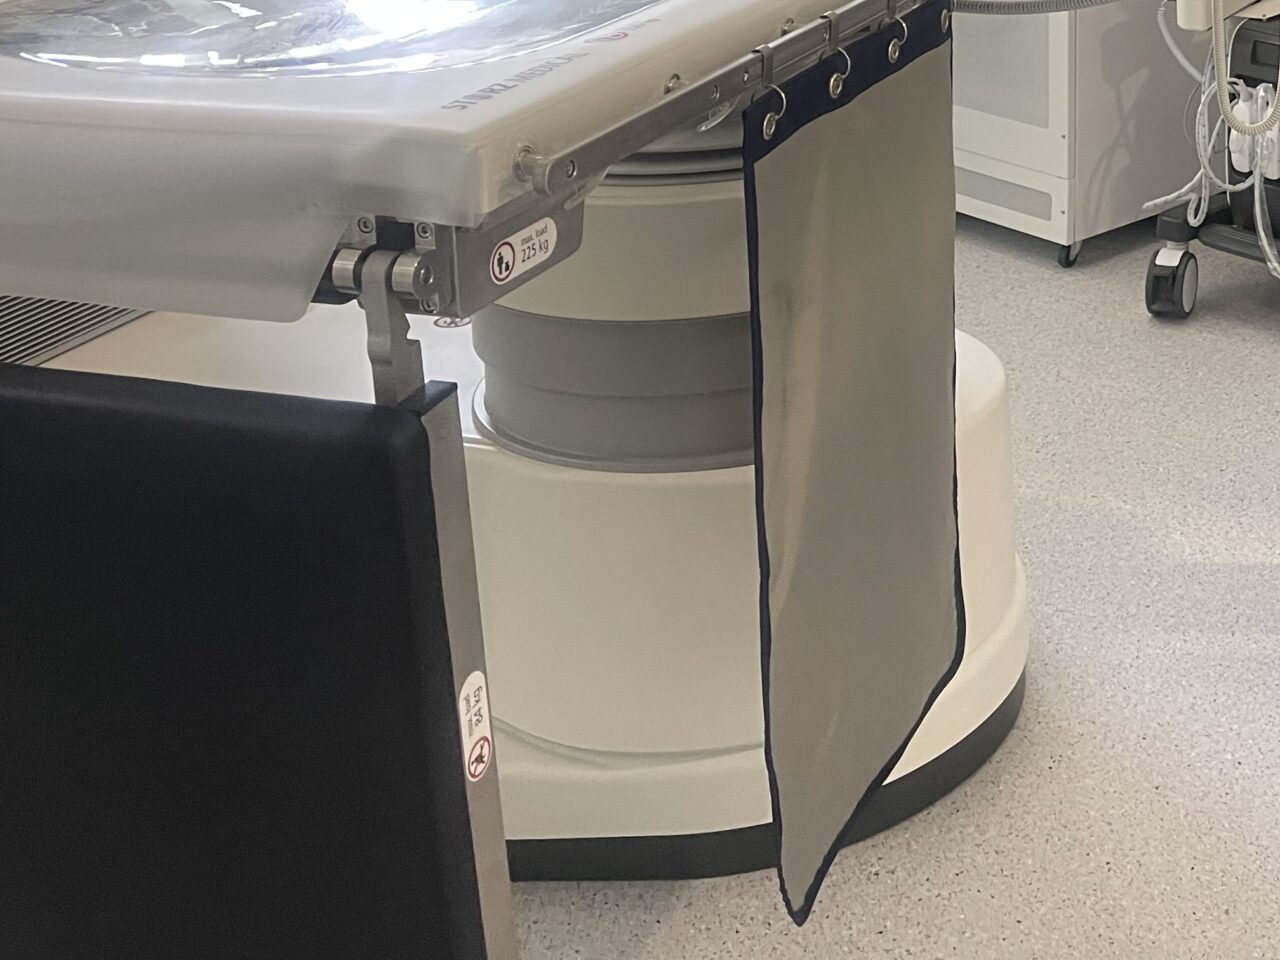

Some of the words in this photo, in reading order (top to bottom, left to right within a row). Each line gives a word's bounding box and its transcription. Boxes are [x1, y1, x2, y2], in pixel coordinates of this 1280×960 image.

[535, 222, 548, 238] load
[521, 242, 537, 263] 225
[538, 238, 549, 254] kg
